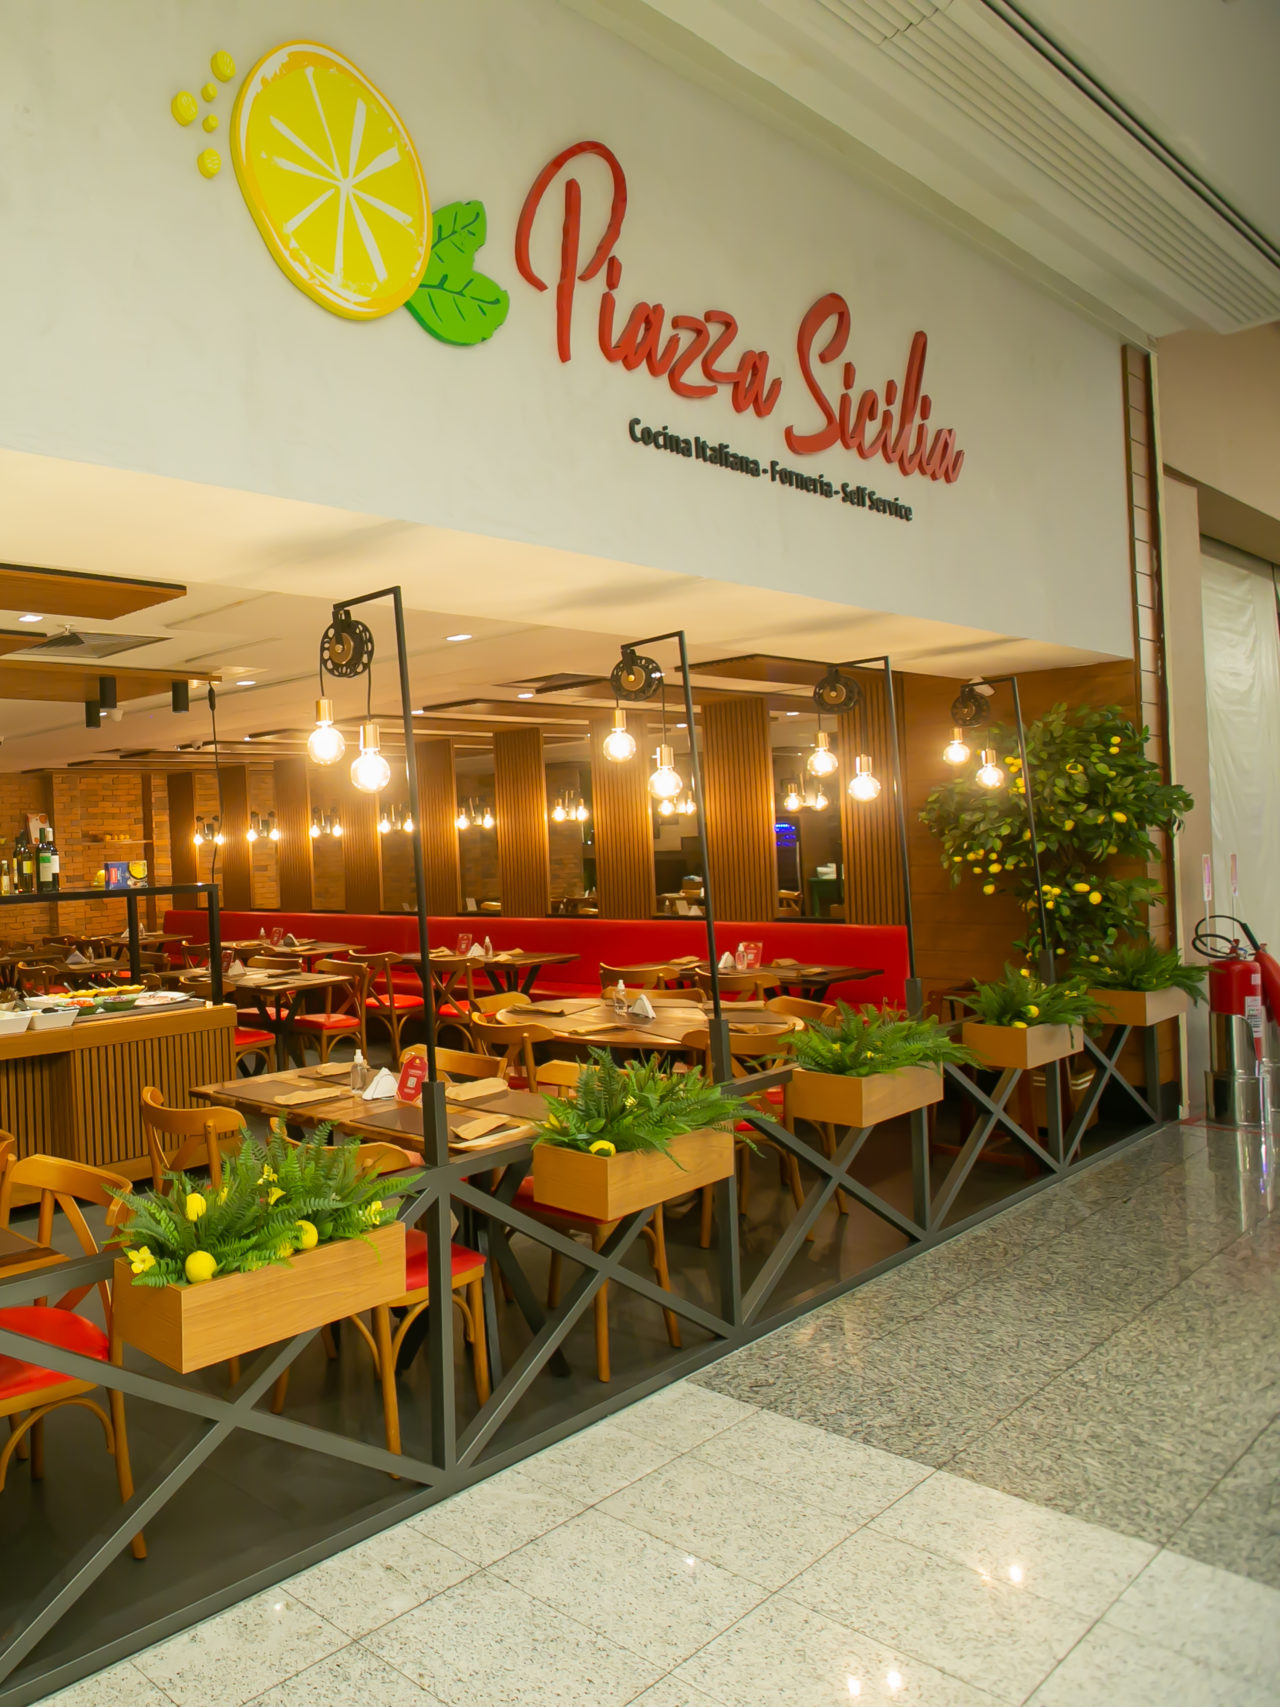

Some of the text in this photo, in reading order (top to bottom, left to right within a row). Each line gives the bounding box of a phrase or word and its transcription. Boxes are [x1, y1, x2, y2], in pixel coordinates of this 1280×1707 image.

[515, 140, 965, 483] Piazza Sicilia
[628, 417, 693, 458] Cocina
[694, 436, 761, 477] Italiana
[770, 460, 834, 498] Forneria
[841, 482, 867, 509] Self
[867, 490, 913, 522] Service
